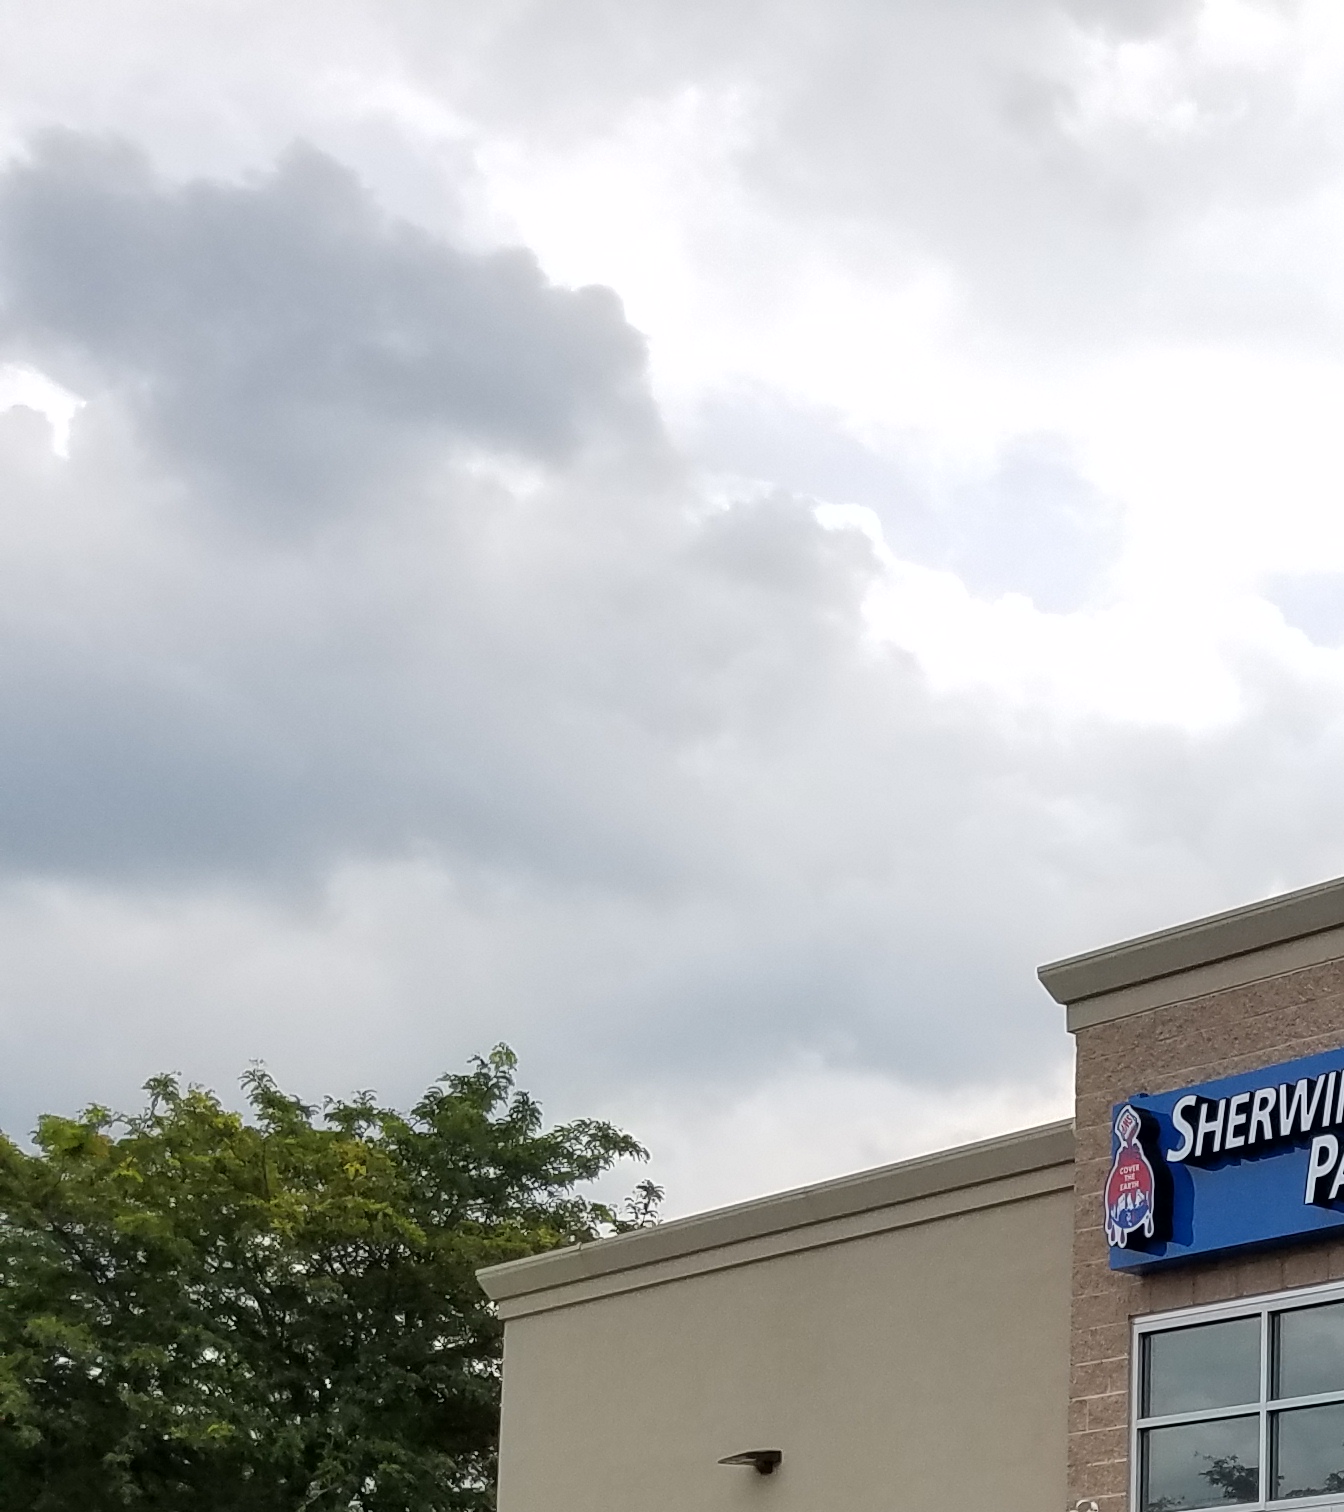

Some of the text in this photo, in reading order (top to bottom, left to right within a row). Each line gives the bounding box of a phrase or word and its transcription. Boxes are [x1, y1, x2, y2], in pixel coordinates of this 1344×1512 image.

[1119, 1164, 1140, 1175] COVER
[1124, 1172, 1136, 1181] THE
[1119, 1181, 1140, 1192] EARTH
